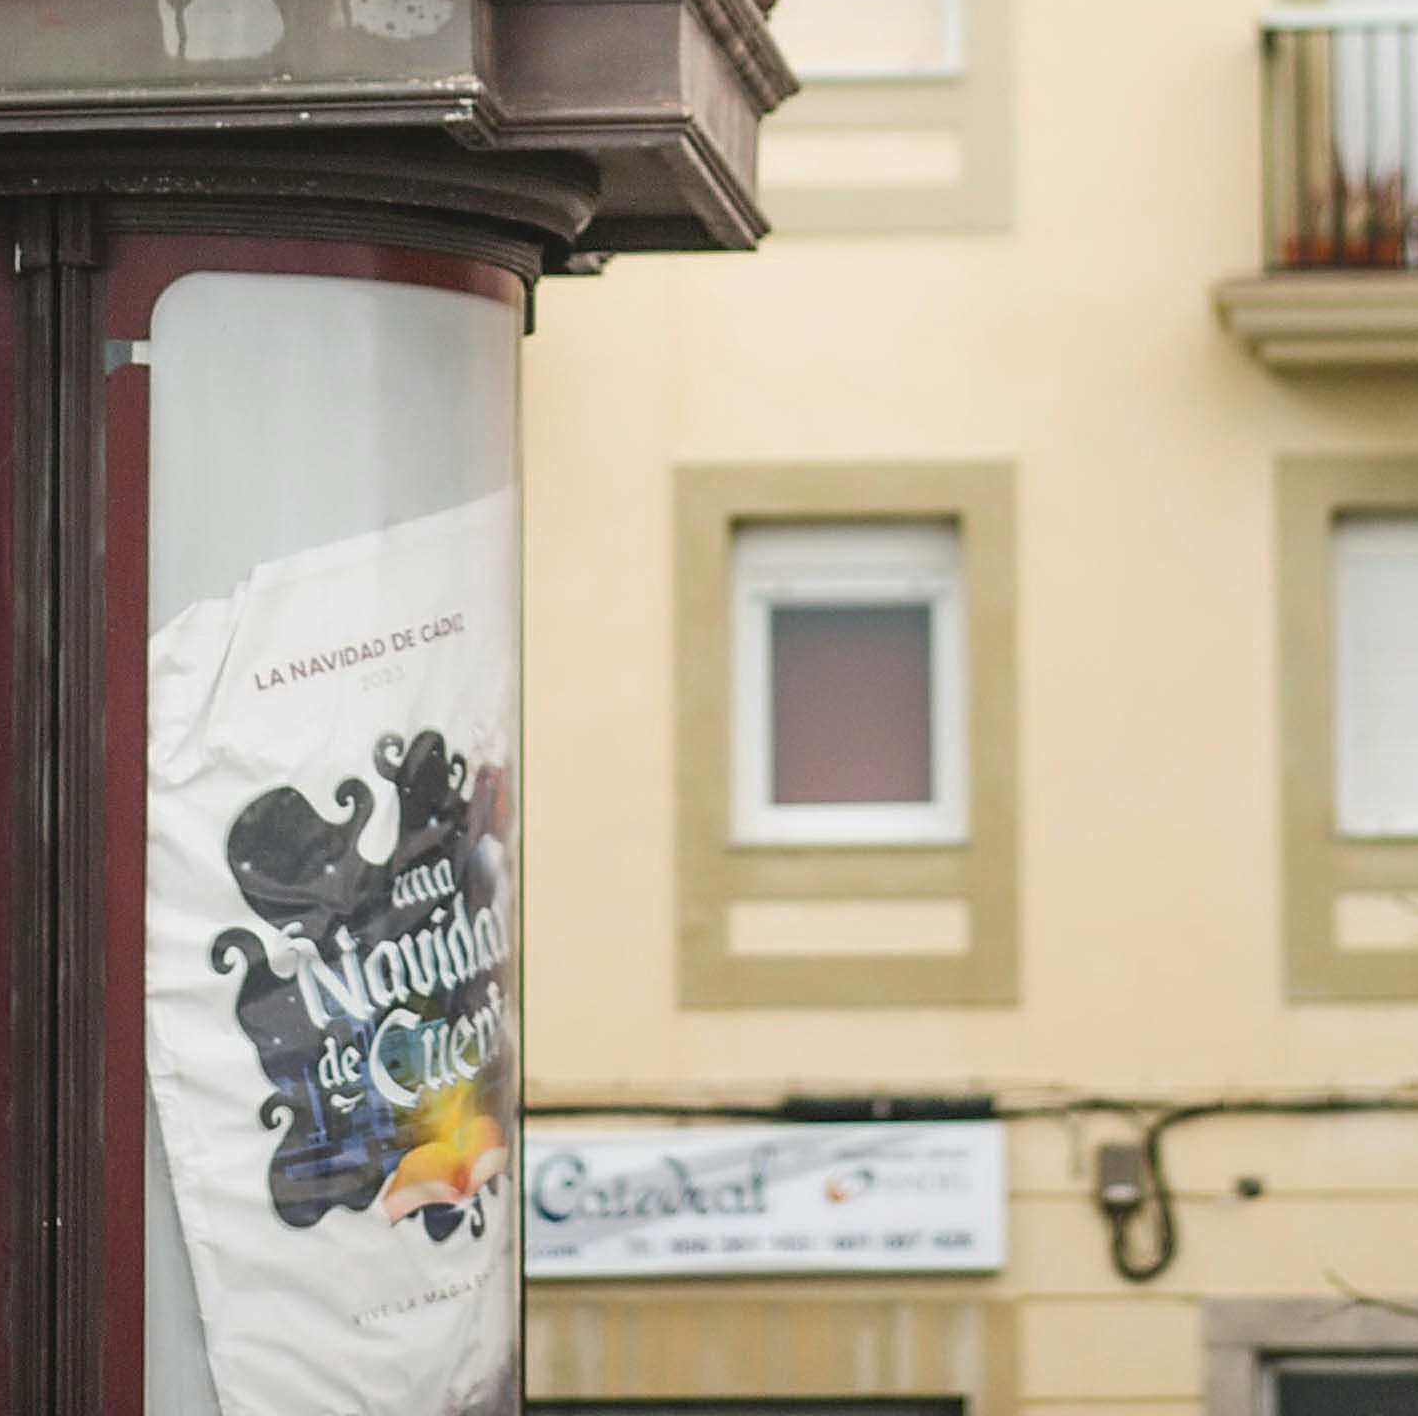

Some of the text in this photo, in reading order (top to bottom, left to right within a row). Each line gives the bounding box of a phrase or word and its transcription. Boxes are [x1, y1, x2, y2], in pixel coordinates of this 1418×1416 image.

[254, 667, 285, 691] LA
[289, 639, 386, 680] NAVIDAD
[392, 625, 417, 652] DE
[392, 858, 455, 909] una
[319, 1037, 362, 1090] de
